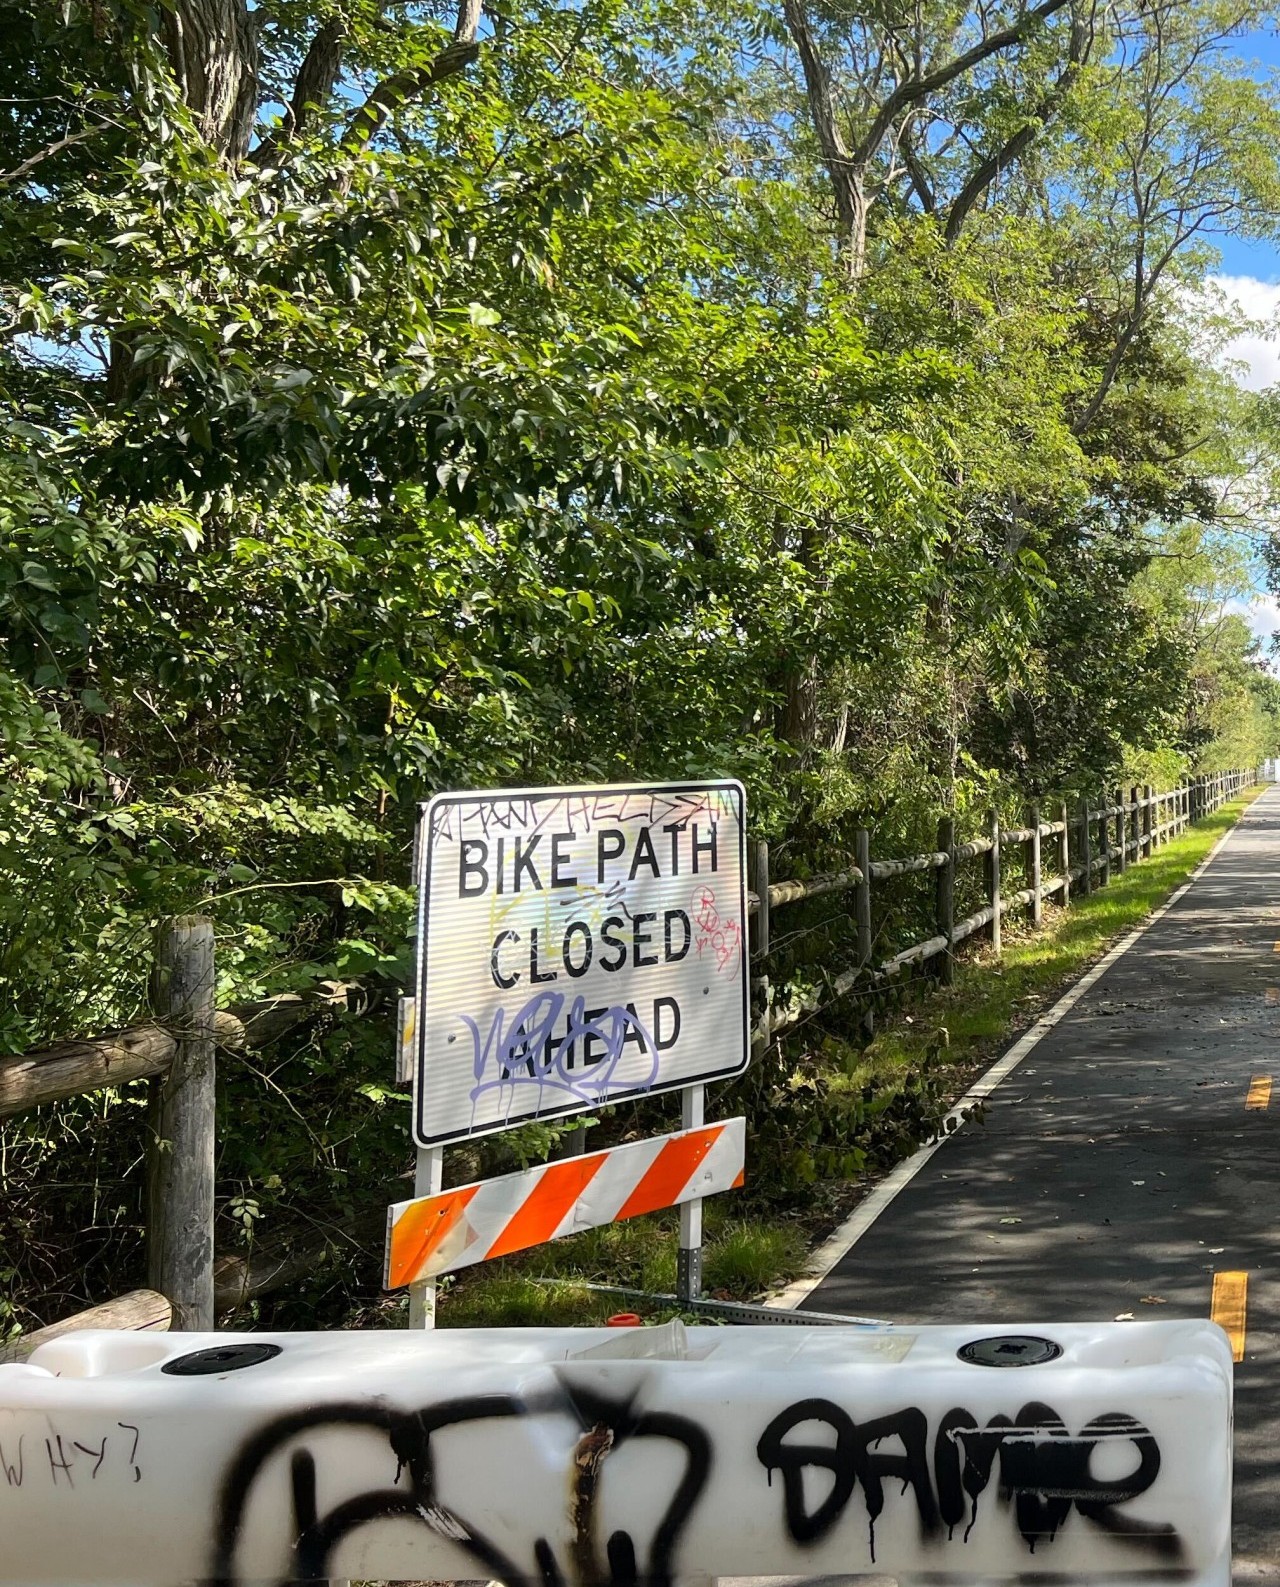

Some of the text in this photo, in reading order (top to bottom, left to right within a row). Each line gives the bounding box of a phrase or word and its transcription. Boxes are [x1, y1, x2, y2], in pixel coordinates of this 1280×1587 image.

[459, 822, 719, 899] BIKE PATH
[491, 909, 691, 989] CLOSED
[501, 997, 681, 1080] AHEAD
[0, 1422, 142, 1490] WHY?
